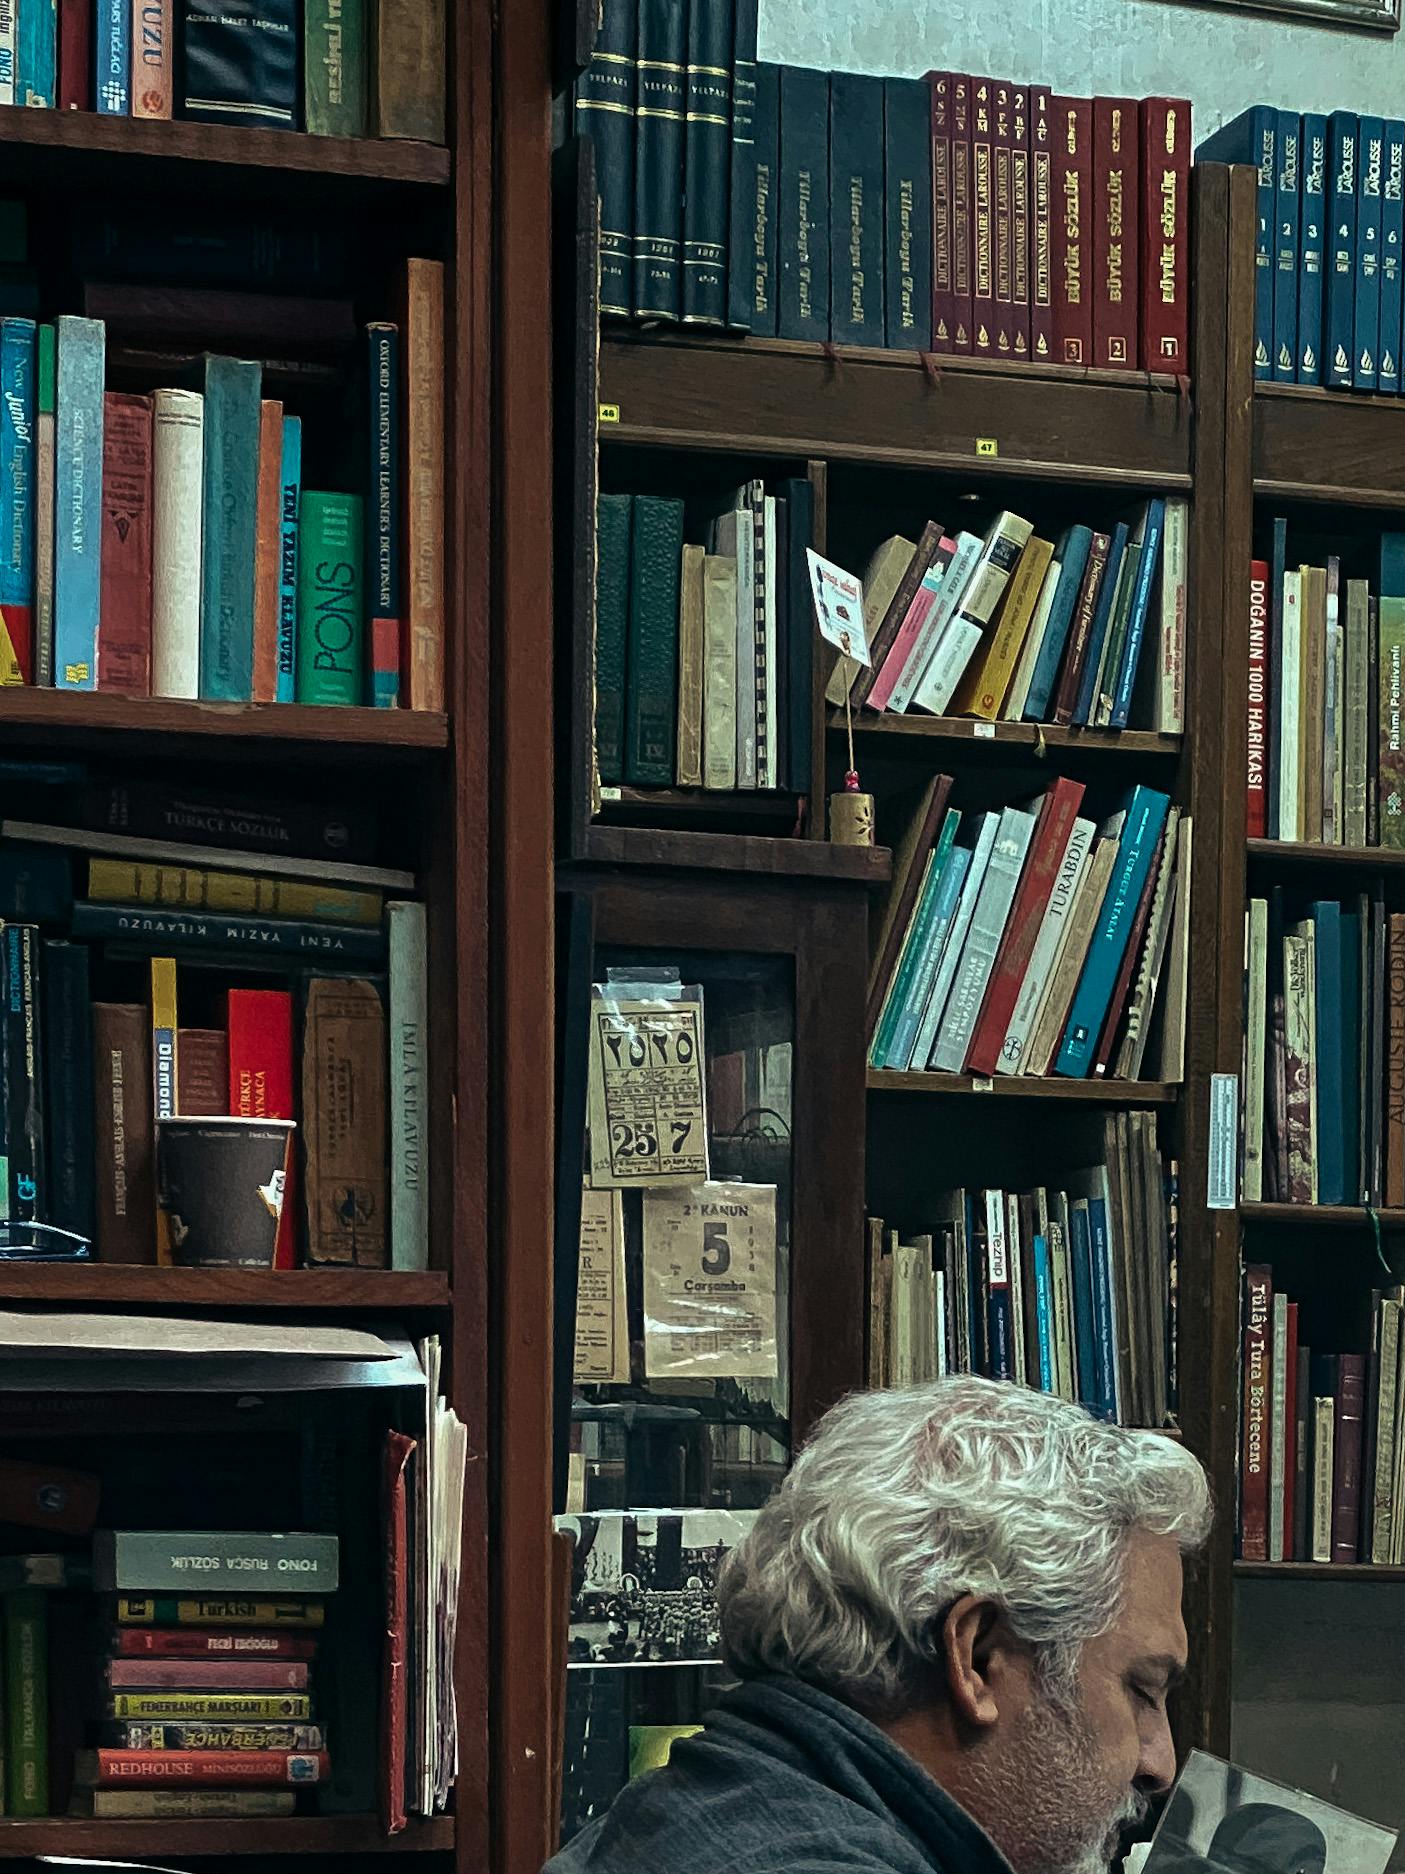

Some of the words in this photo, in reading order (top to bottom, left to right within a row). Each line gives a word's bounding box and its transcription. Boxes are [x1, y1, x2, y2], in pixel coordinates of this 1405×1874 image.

[937, 80, 947, 94] 6
[956, 85, 965, 99] 5
[977, 86, 987, 102] 4
[998, 90, 1007, 105] 3
[1015, 94, 1024, 110] 2
[1038, 95, 1045, 111] 1
[937, 145, 946, 201] LAROUSSE
[978, 150, 988, 208] LAROUSSE
[1016, 157, 1025, 214] LAROUSSE
[1038, 158, 1047, 216] LAROUSSE
[1262, 130, 1273, 188] LAROUSSE
[1285, 136, 1296, 191] LAROUSSE
[1312, 137, 1323, 194] LAROUSSE
[1342, 137, 1354, 194] LAROUSSE
[1367, 139, 1381, 196] LAROUSSE
[1389, 143, 1402, 200] LAROUSSE
[1064, 170, 1079, 238] SÖZLÜK
[1107, 170, 1122, 237] SÖZLÜK
[1161, 170, 1176, 238] SÖZLÜK
[1261, 218, 1266, 231] 1
[1283, 223, 1291, 236] 2
[1308, 225, 1317, 238] 3
[1339, 224, 1348, 237] 4
[938, 214, 947, 284] DICTIONNAIRE
[978, 212, 988, 291] DICTIONNAIRE
[999, 219, 1009, 294] DICTIONNAIRE
[1016, 221, 1025, 297] DICTIONNAIRE
[1038, 219, 1047, 298] DICTIONNAIRE
[1366, 227, 1375, 240] 5
[1388, 230, 1397, 243] 6
[1065, 244, 1080, 303] BÜYÜK
[1108, 243, 1122, 303] BÜYÜK
[1160, 243, 1176, 303] BÜYÜK
[13, 356, 27, 390] New
[379, 339, 391, 388] OXFORD
[1068, 343, 1078, 357] 3
[1112, 342, 1122, 356] 2
[1166, 342, 1173, 356] 1
[5, 391, 32, 443] Junior
[379, 391, 391, 468] ELEMENTARY
[8, 445, 28, 495] English
[8, 499, 28, 575] Dictionary
[71, 468, 84, 554] DICTIONARY
[379, 535, 391, 608] DICTIONARY
[315, 561, 355, 674] PONS
[1248, 580, 1265, 659] DOĞANIN
[1248, 665, 1263, 701] 1000
[1247, 707, 1264, 789] HARİKASI
[1389, 710, 1400, 749] Rahmi
[1050, 829, 1088, 917] TURABDIN
[1116, 848, 1140, 896] TURGUT
[226, 926, 281, 944] YAZIM
[1389, 929, 1405, 1007] RODIN
[158, 1043, 173, 1118] Diamond
[402, 1086, 419, 1191] KILAVUZU
[613, 1120, 658, 1159] 25
[671, 1120, 692, 1155] 7
[702, 1222, 731, 1276] 5
[1250, 1339, 1264, 1379] Tura
[278, 1559, 318, 1572] FONO
[109, 1761, 193, 1776] REDHOUSE
